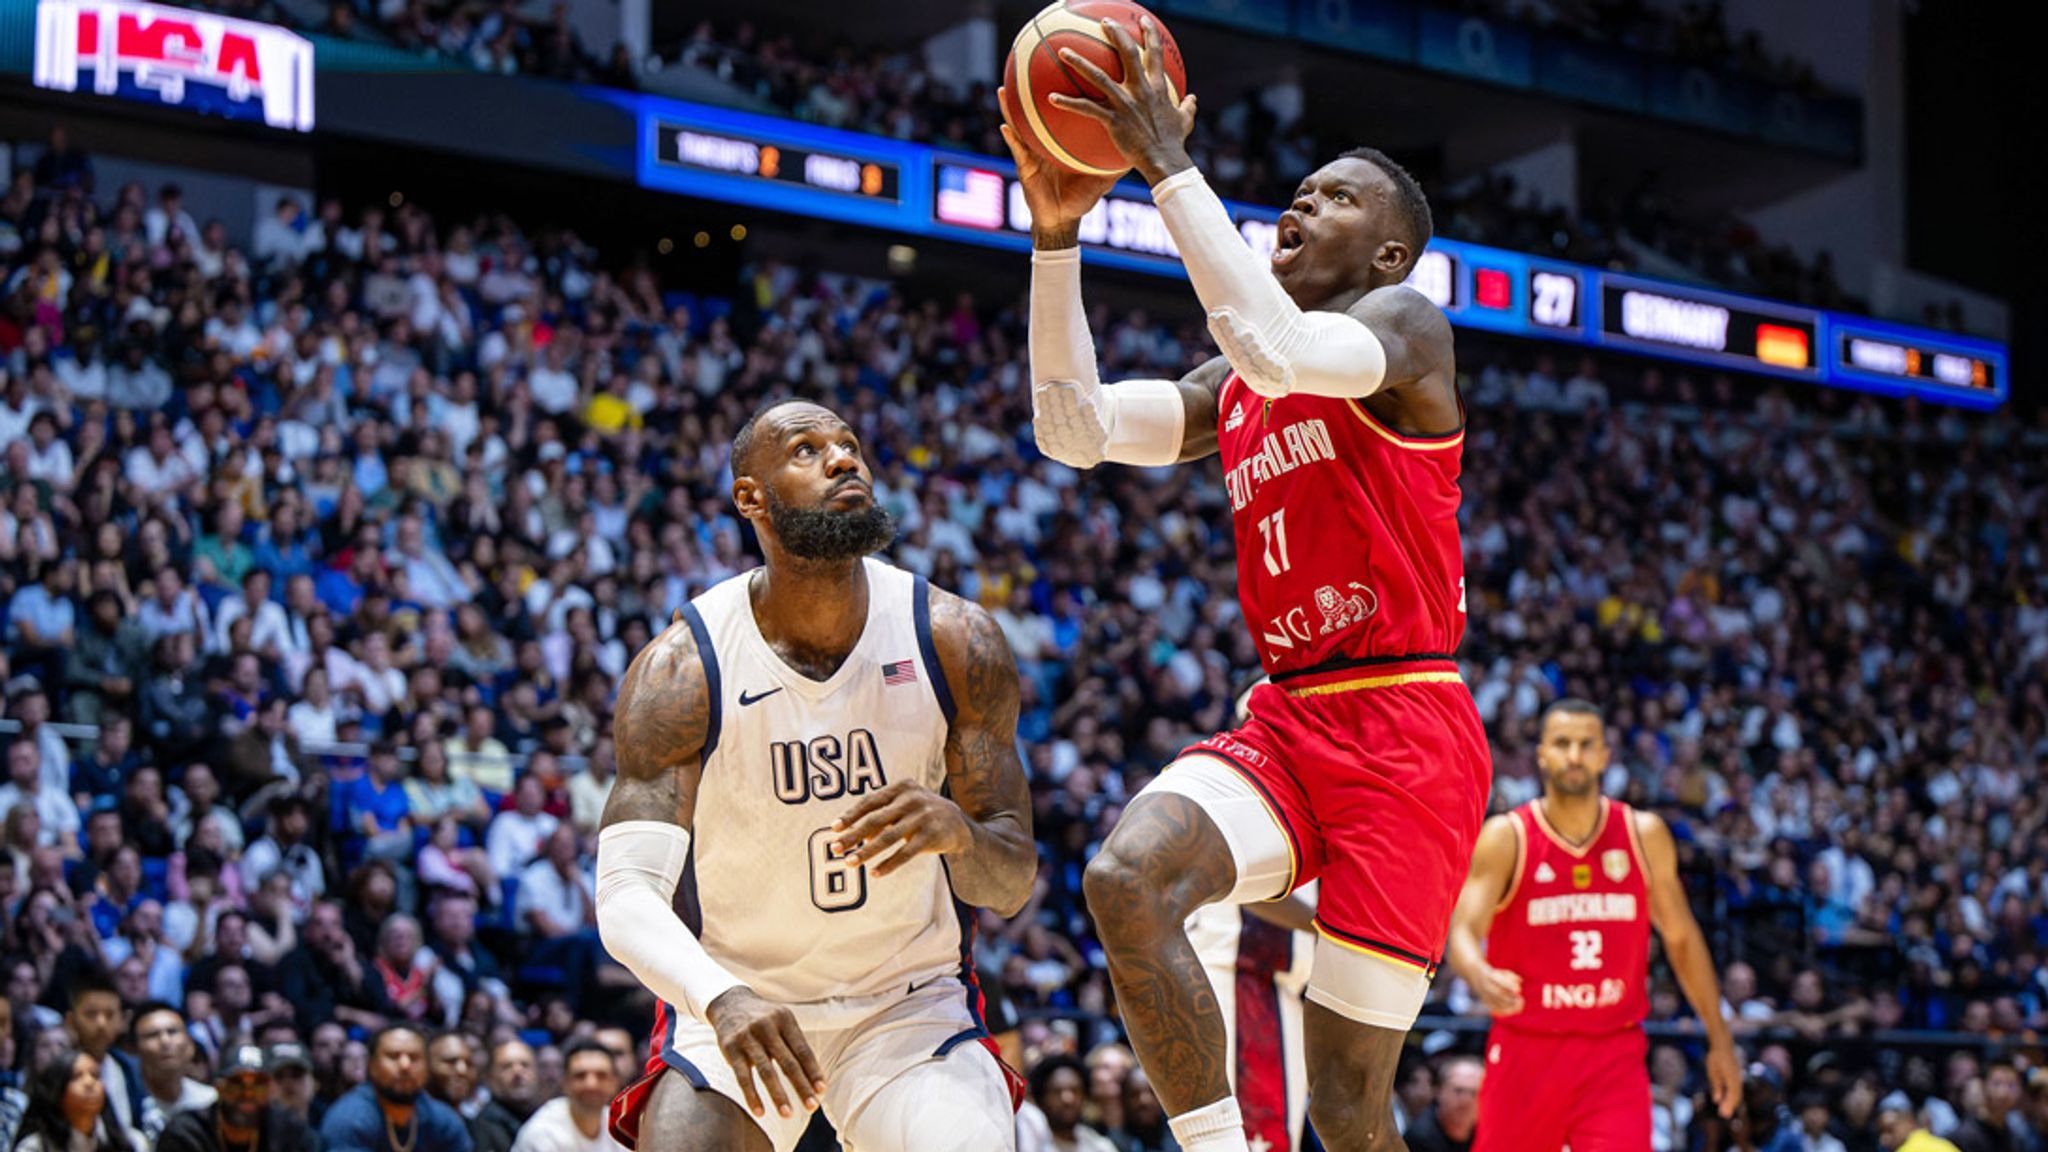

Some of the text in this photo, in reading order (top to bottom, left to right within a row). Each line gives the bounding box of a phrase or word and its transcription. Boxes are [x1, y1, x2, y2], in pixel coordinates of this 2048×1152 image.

[770, 728, 888, 805] USA
[808, 826, 868, 914] 6
[1526, 892, 1637, 926] DEUTSCHLAND
[1569, 930, 1603, 971] 32
[1541, 983, 1596, 1008] ING
